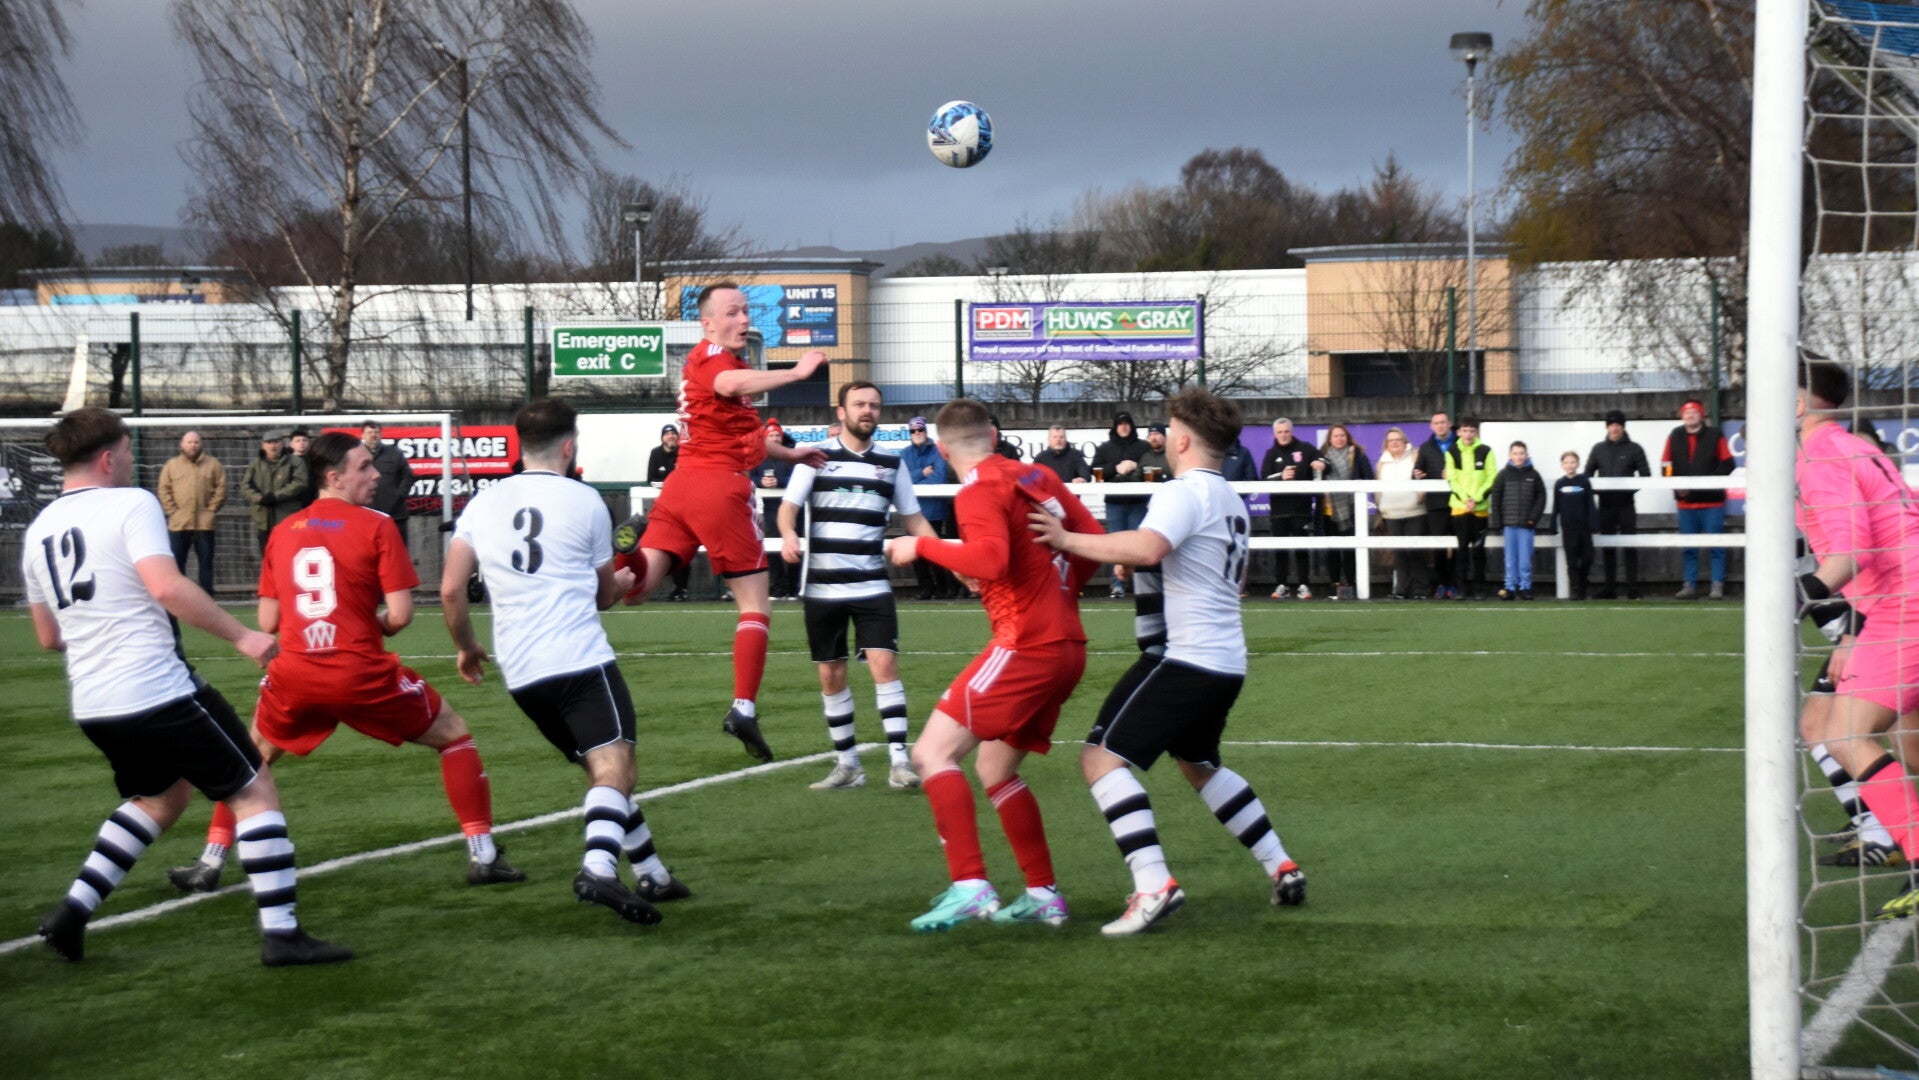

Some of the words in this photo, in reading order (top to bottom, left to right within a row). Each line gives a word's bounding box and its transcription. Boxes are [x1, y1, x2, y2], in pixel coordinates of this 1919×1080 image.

[786, 288, 818, 299] UNIT
[821, 288, 836, 299] 15
[979, 310, 1030, 329] PDM
[1050, 311, 1113, 329] HUWS
[1137, 310, 1191, 329] GRAY
[557, 332, 660, 352] Emergency
[973, 345, 998, 354] Proud
[999, 346, 1035, 355] sponsors
[1036, 345, 1046, 353] of
[1047, 345, 1061, 353] the
[1062, 345, 1083, 353] West
[1084, 344, 1094, 353] of
[1095, 344, 1130, 353] Scotland
[1132, 344, 1166, 352] Football
[1167, 344, 1198, 353] League
[576, 353, 611, 370] exit
[620, 353, 636, 370] C
[397, 437, 507, 458] STORAGE
[511, 506, 544, 575] 3
[41, 526, 96, 610] 12
[293, 546, 338, 619] 9
